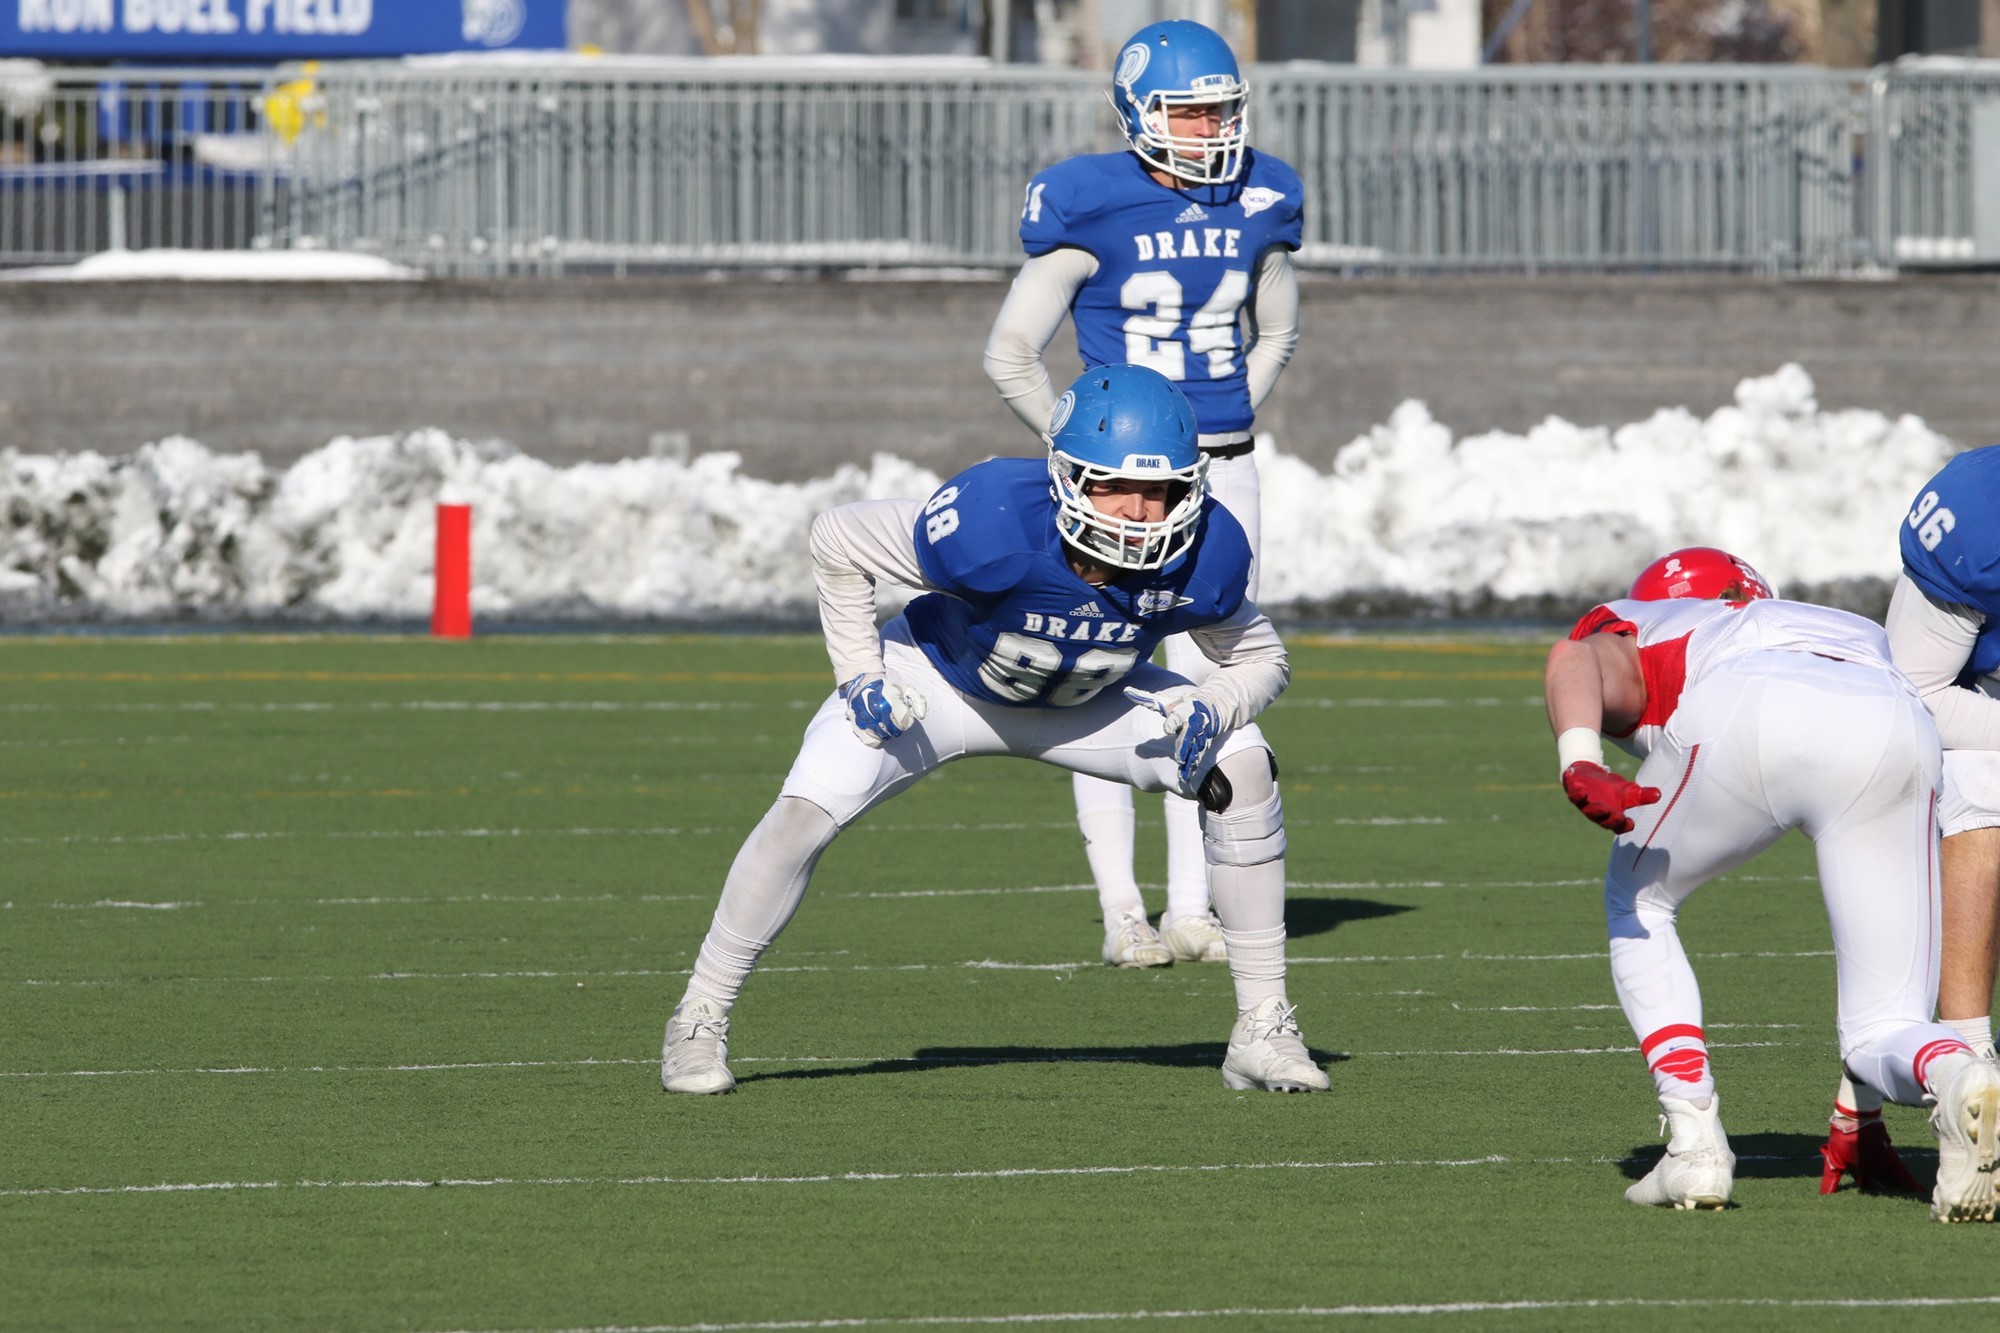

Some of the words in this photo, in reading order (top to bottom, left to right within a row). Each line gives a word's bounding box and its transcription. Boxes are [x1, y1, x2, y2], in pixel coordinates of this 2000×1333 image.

[245, 0, 374, 35] FIELD
[1204, 76, 1223, 87] DRAKE
[1021, 182, 1047, 223] 4
[1133, 228, 1241, 261] DRAKE
[1120, 268, 1249, 381] 24
[1136, 458, 1161, 469] DRAKE
[925, 485, 961, 546] 88
[1908, 490, 1956, 553] 96
[1023, 612, 1143, 643] DRAKE
[1069, 608, 1104, 619] adidas
[977, 631, 1140, 707] 88
